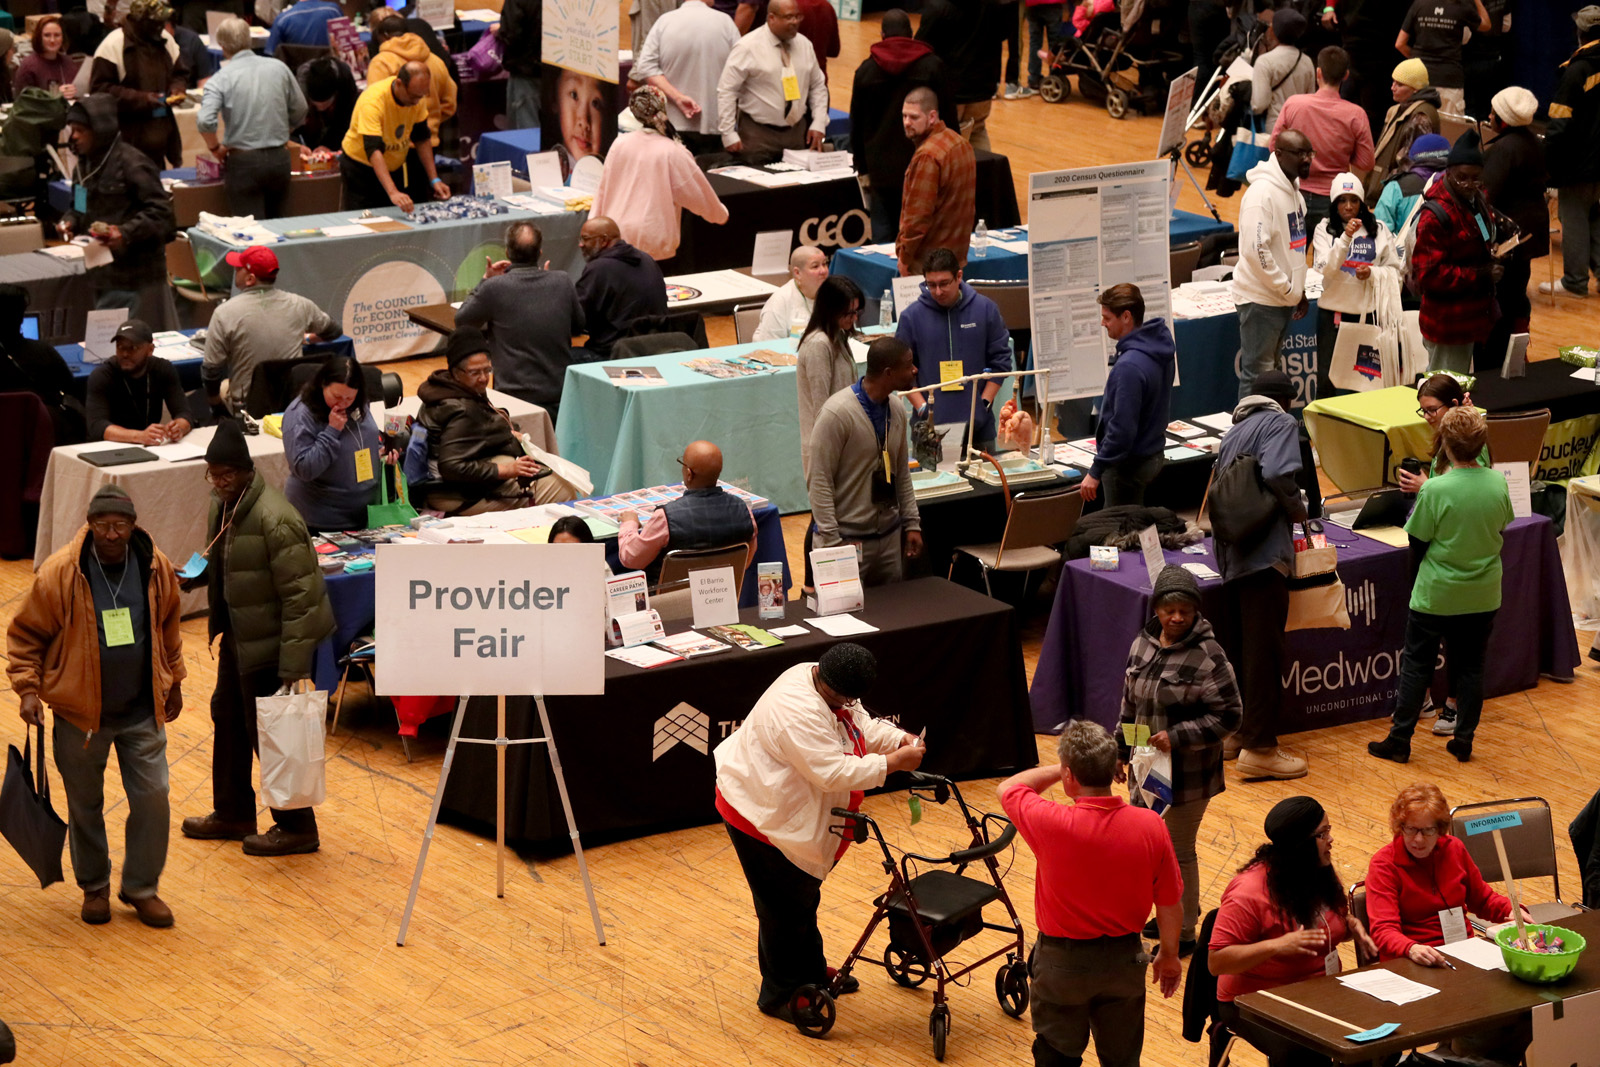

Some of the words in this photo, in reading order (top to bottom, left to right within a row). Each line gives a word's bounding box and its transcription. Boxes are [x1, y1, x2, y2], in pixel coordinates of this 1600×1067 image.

[569, 36, 592, 51] HEAD
[568, 49, 593, 66] START
[1054, 175, 1071, 184] 2020
[1072, 173, 1097, 182] Census
[1098, 168, 1145, 180] Questionnaire
[353, 302, 373, 314] The
[375, 295, 428, 310] COUNCIL
[353, 314, 368, 325] for
[370, 309, 411, 323] ECONO
[364, 334, 393, 344] Greater
[610, 584, 629, 593] CAREER
[629, 581, 645, 590] PATH?
[707, 576, 725, 584] Barrio
[409, 579, 570, 611] Provider
[698, 586, 728, 596] Workforce
[704, 597, 724, 605] Center
[453, 628, 525, 659] Fair
[1281, 643, 1446, 696] Medwors
[1306, 692, 1383, 714] UNCONDITIONAL
[1386, 688, 1400, 699] CA
[718, 720, 742, 738] TH
[1470, 814, 1516, 829] INFORMATION
